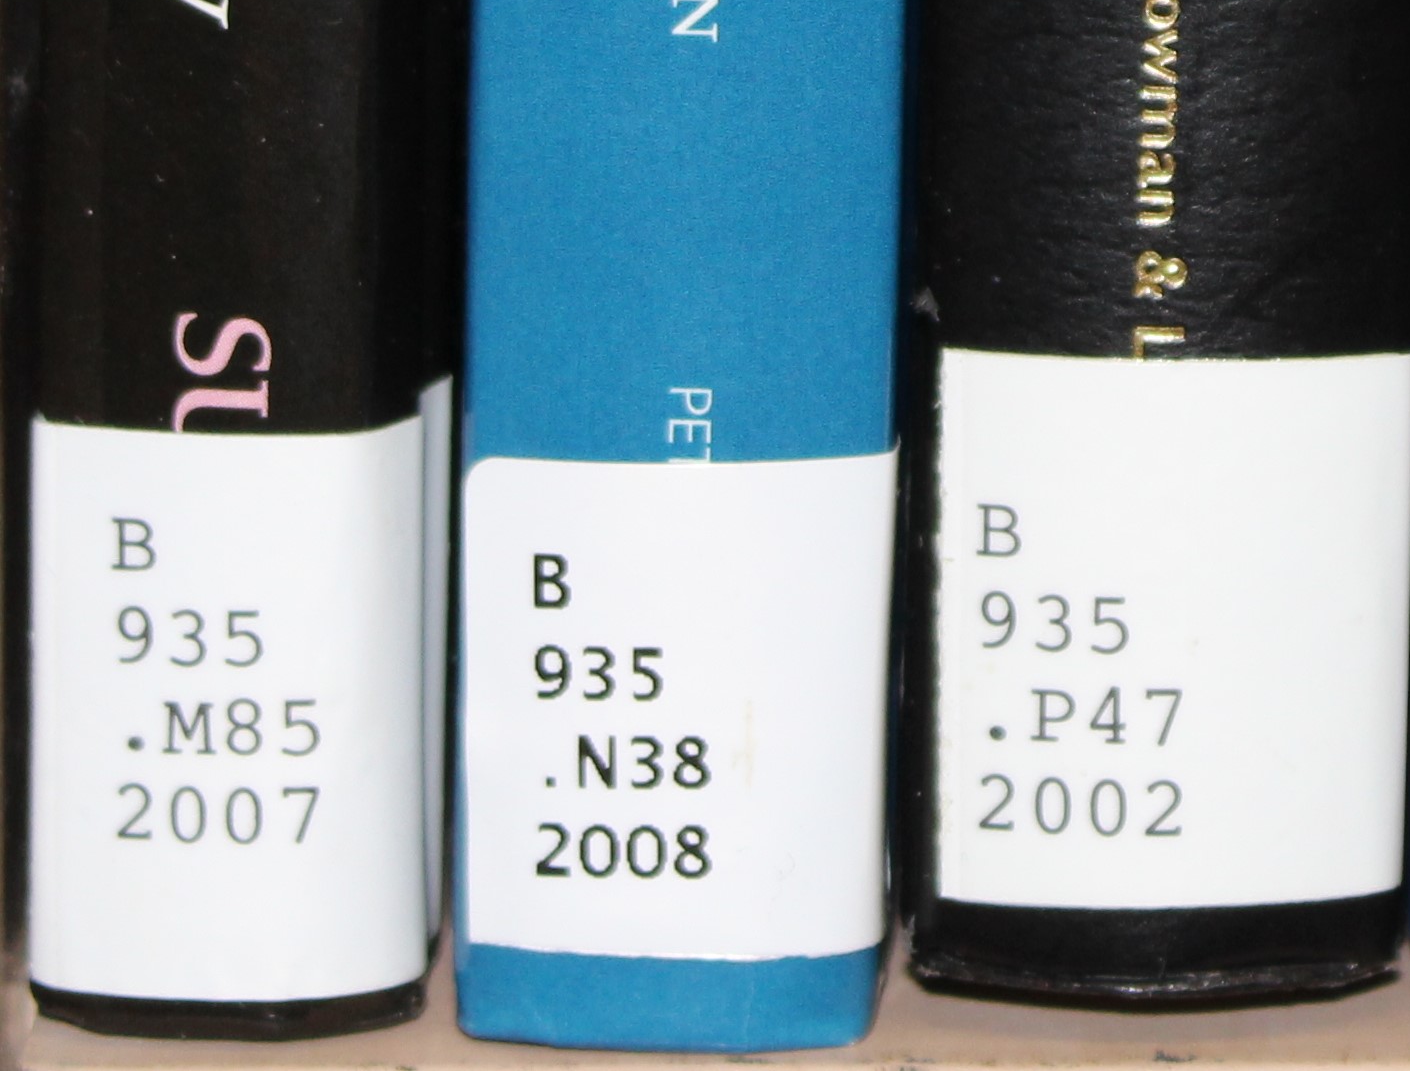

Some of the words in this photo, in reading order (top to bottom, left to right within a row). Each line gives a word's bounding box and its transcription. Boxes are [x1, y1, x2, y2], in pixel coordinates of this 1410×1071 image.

[1132, 250, 1188, 301] &
[112, 518, 155, 570] B
[977, 504, 1020, 556] B
[533, 553, 570, 609] B
[118, 606, 261, 666] 935
[981, 591, 1127, 654] 935
[534, 644, 662, 701] 935
[127, 699, 319, 754] .M85
[989, 687, 1179, 745] .P47
[543, 735, 711, 789] .N38
[117, 783, 318, 843] 2007
[979, 774, 1180, 836] 2002
[535, 822, 711, 879] 2008
